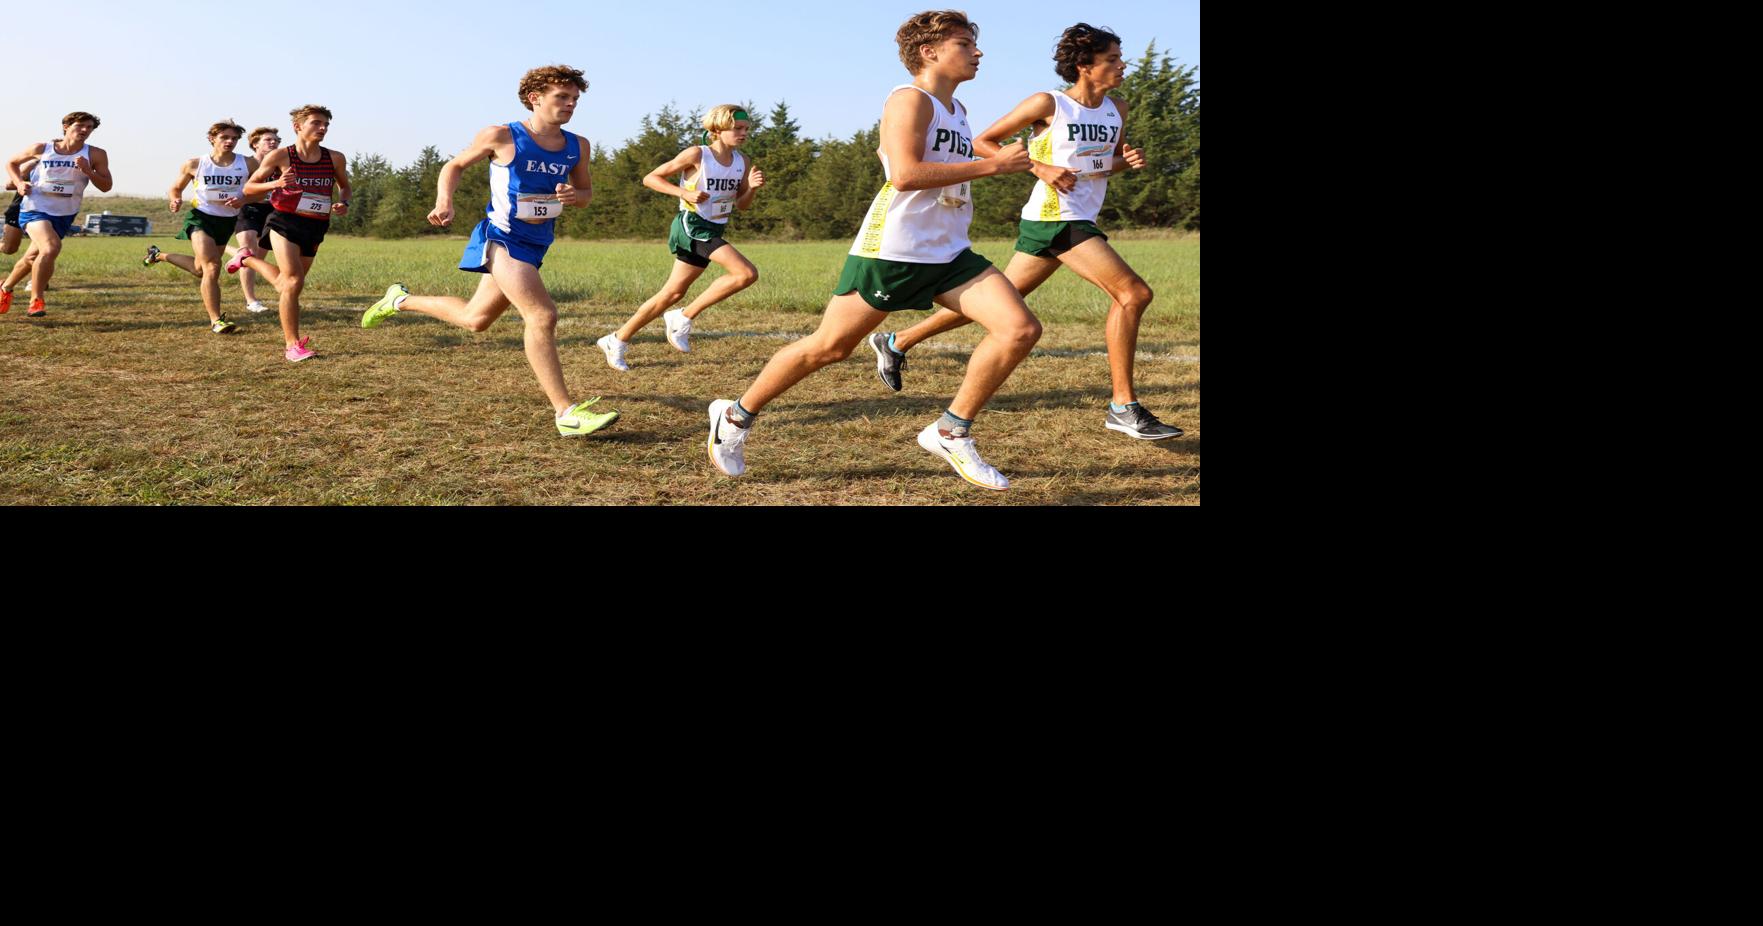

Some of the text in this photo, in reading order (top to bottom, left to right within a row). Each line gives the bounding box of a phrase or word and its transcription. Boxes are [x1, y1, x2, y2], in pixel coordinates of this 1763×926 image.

[1067, 123, 1108, 142] PIUS
[526, 160, 569, 176] EAST
[1092, 159, 1104, 169] 166
[203, 175, 243, 185] PIUS X
[706, 178, 735, 191] PIUS
[534, 206, 548, 216] 153
